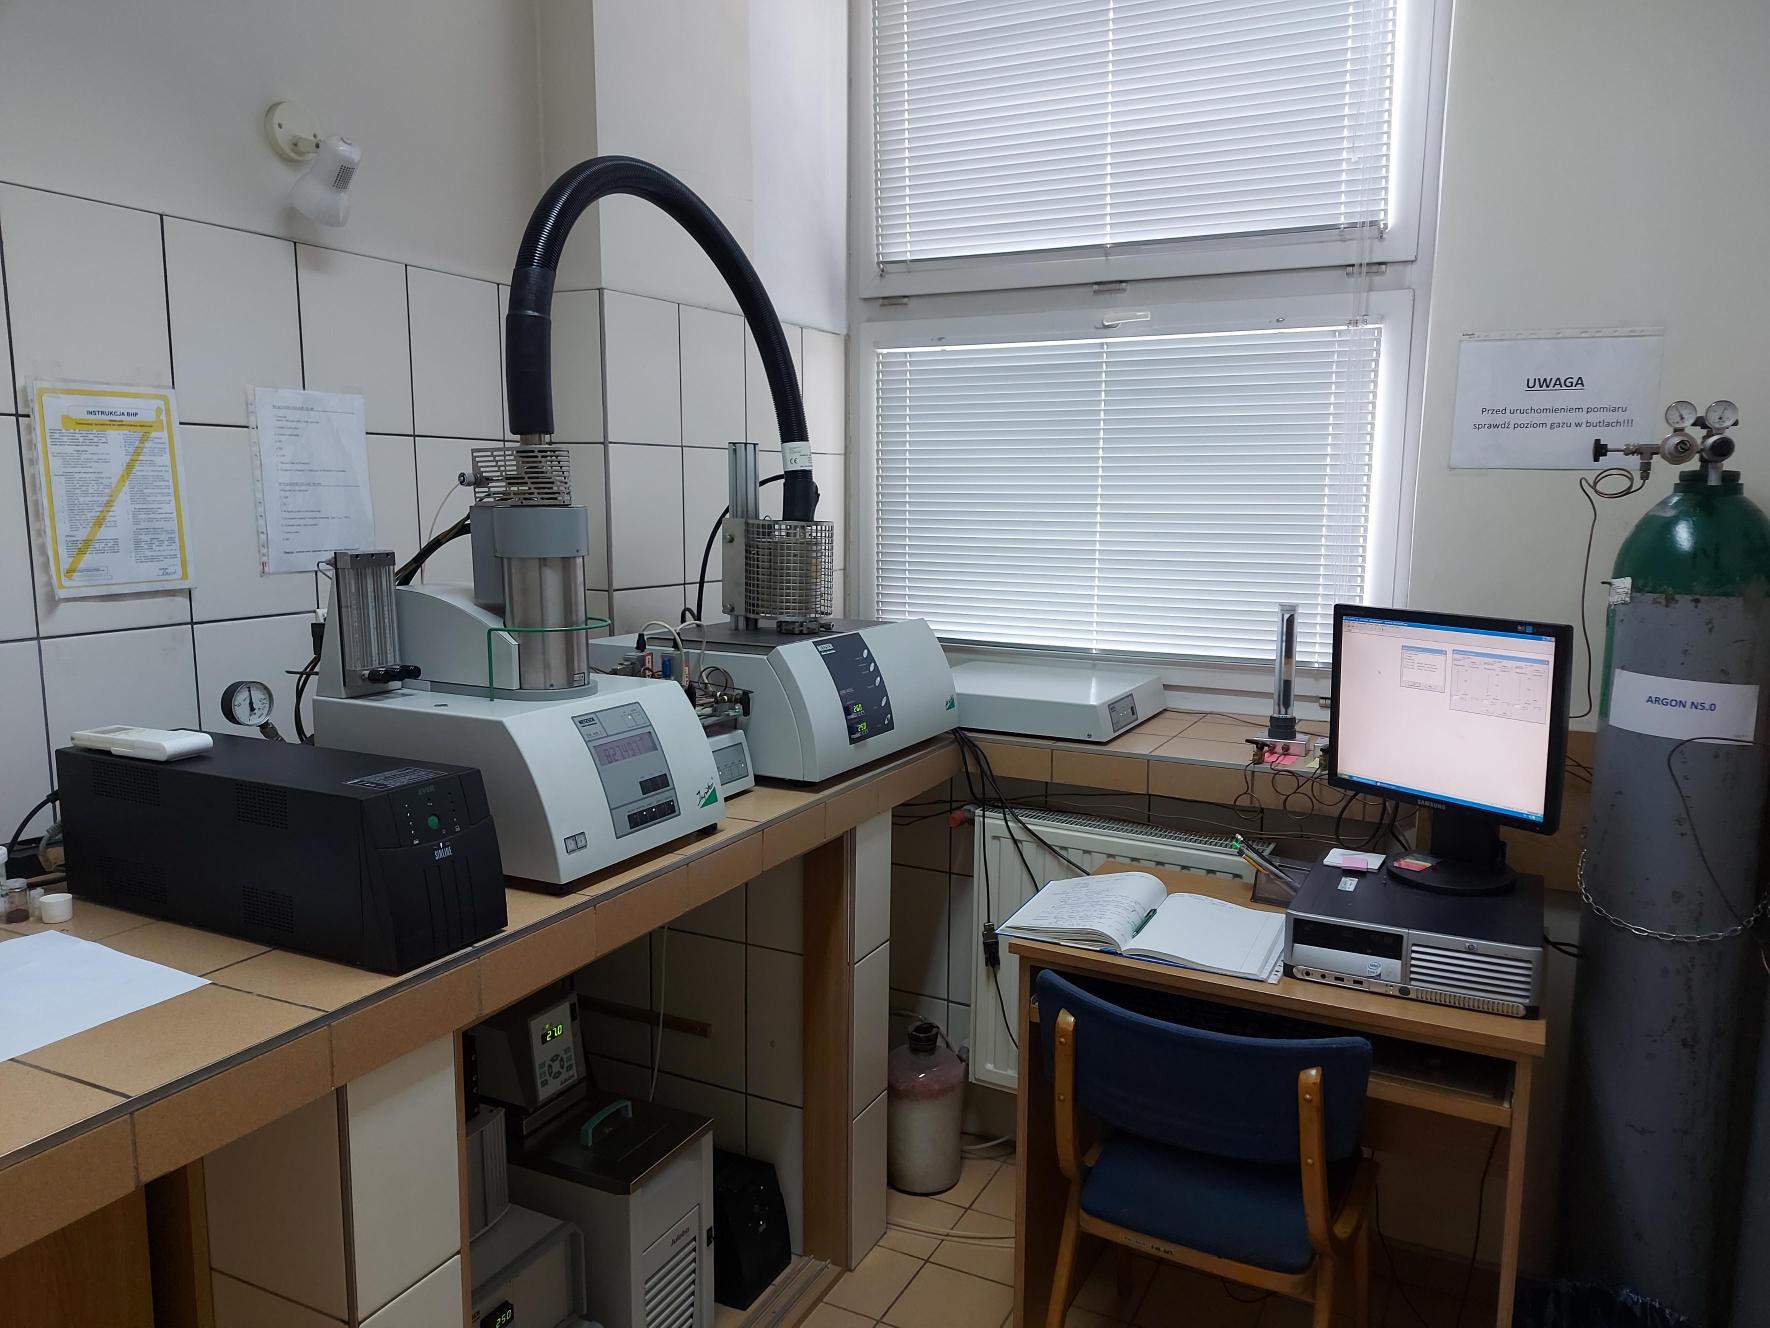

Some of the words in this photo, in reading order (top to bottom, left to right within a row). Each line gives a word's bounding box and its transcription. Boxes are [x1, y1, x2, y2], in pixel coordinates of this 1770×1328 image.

[1525, 376, 1585, 389] UWAGA
[86, 409, 126, 418] INSTRUKCJA
[1481, 406, 1507, 416] Przed
[1509, 405, 1584, 415] uruchomieniem
[1586, 405, 1628, 416] pomiaru
[1472, 420, 1511, 431] sprawdź
[1513, 419, 1548, 431] poziom
[1549, 420, 1572, 431] gazu
[1574, 420, 1583, 429] w
[1585, 418, 1634, 429] butlach!!!
[1645, 695, 1687, 709] ARGON
[1689, 701, 1717, 712] N5.0
[1417, 799, 1446, 810] SAMSUNG
